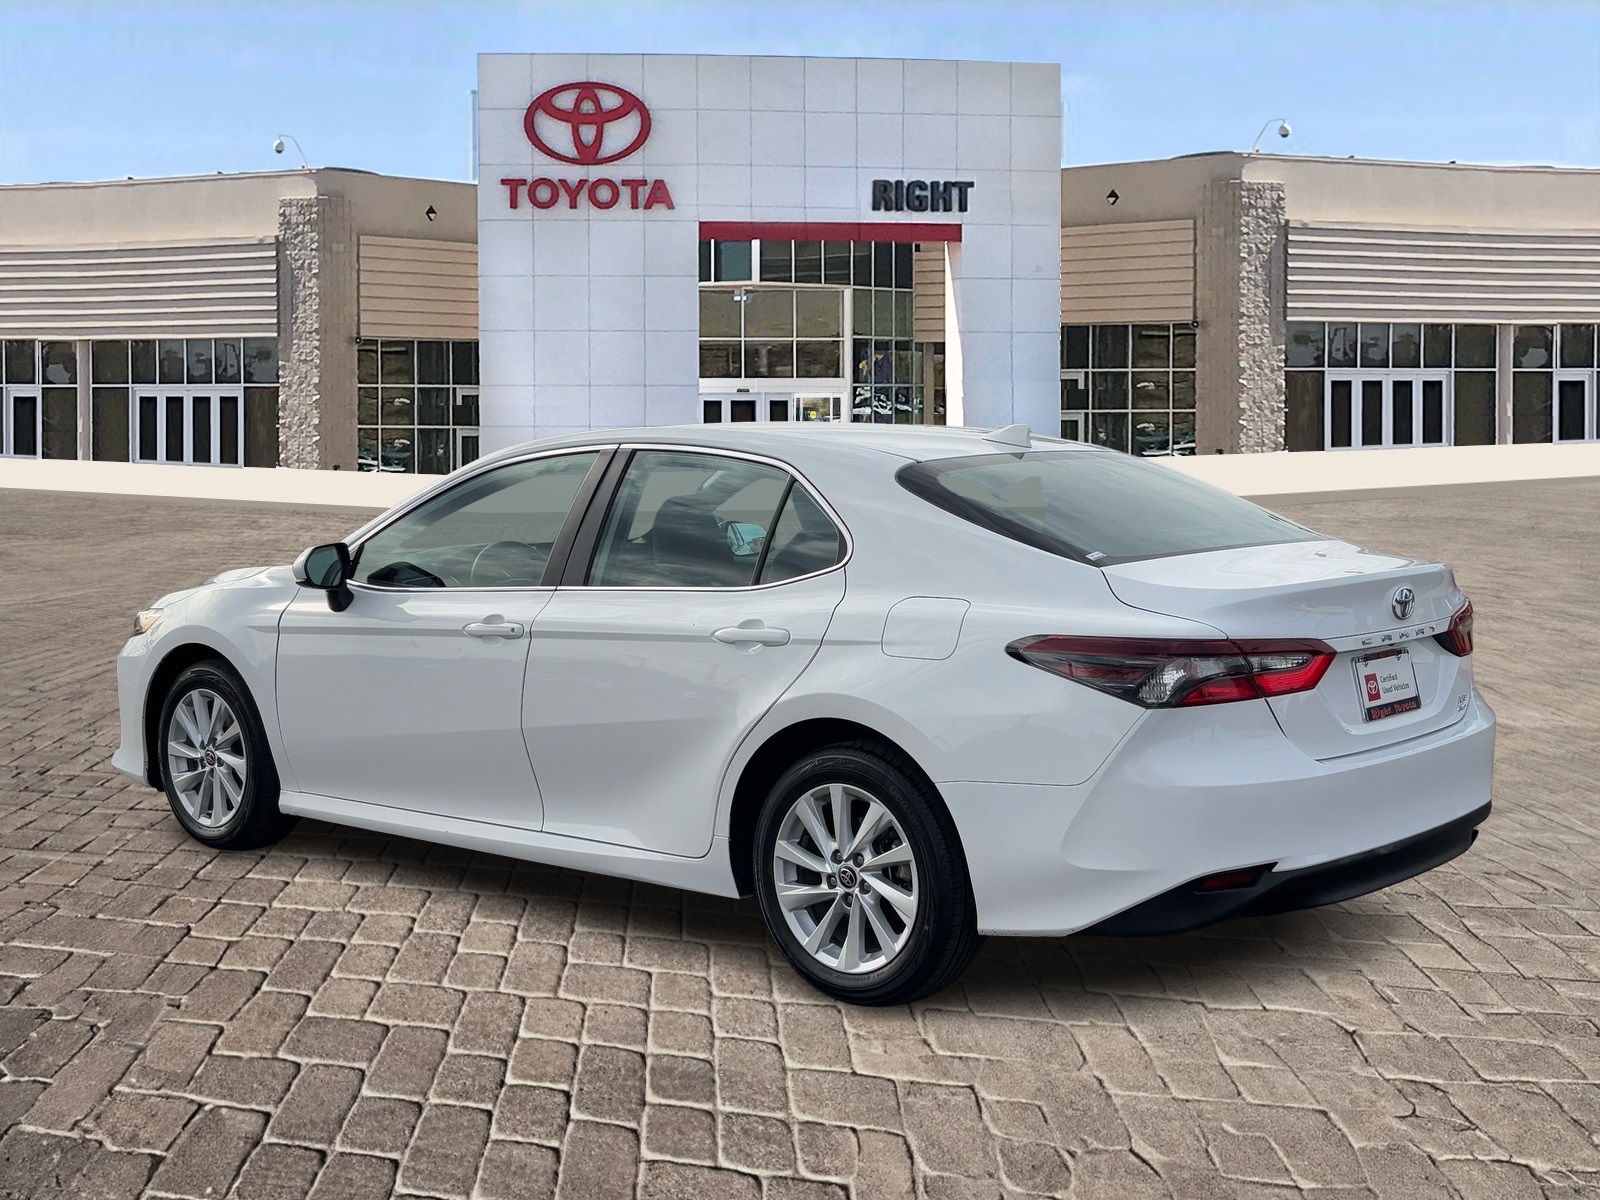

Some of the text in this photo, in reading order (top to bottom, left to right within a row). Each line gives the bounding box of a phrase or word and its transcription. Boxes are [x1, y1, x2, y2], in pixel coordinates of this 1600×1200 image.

[500, 177, 675, 210] TOYOTA
[872, 179, 974, 212] RIGHT
[1380, 673, 1398, 683] Certified
[1382, 682, 1410, 694] Used Vehicles
[1371, 700, 1417, 719] Right Toyota
